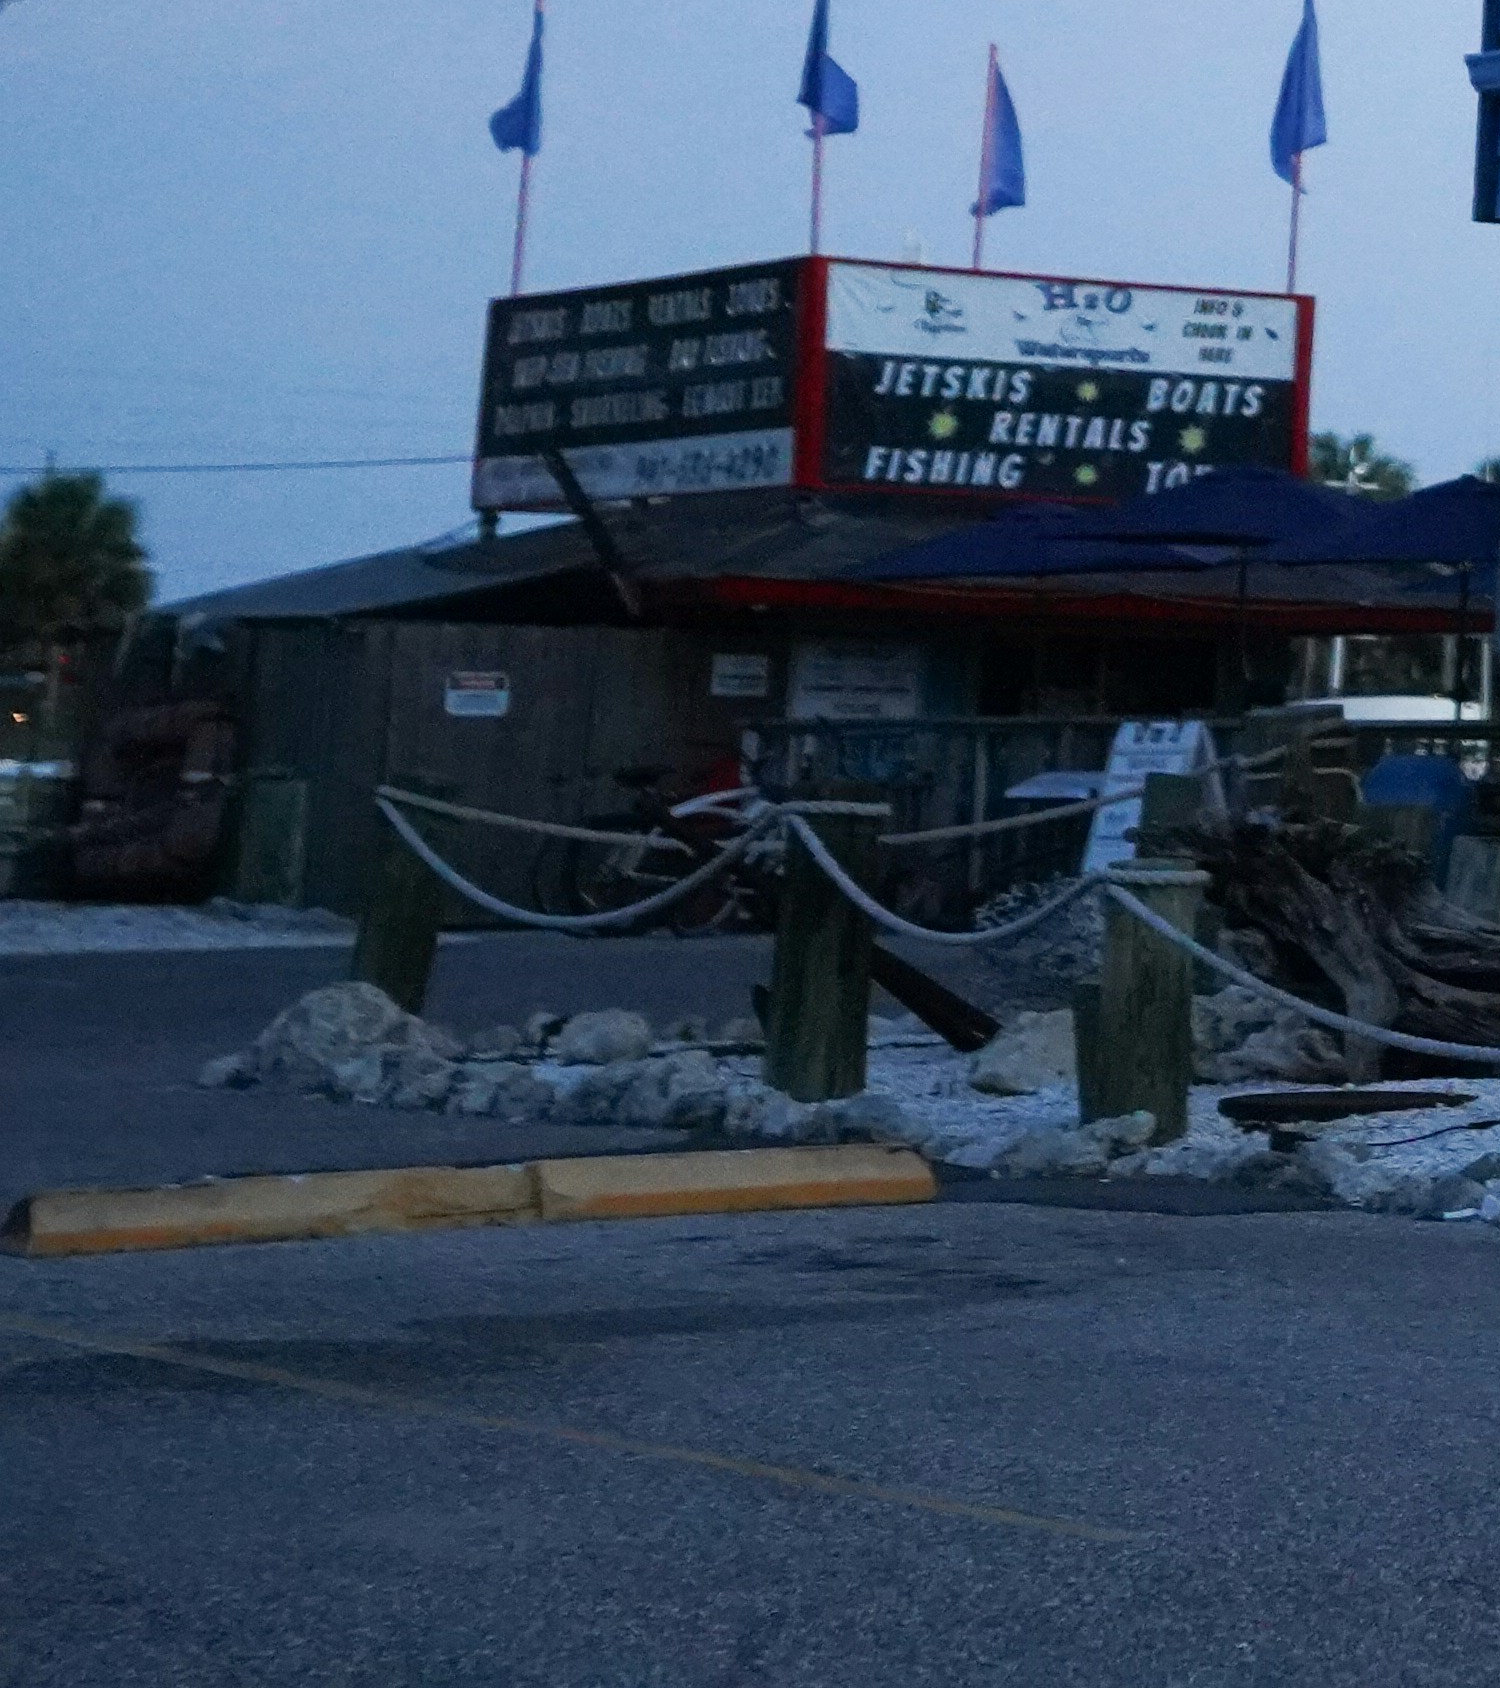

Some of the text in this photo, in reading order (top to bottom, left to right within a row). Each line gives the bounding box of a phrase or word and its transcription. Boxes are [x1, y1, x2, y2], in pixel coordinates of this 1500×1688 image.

[874, 359, 1265, 415] JETSKIS BOATS
[989, 410, 1154, 454] RENTALS
[864, 443, 1027, 490] FISHING
